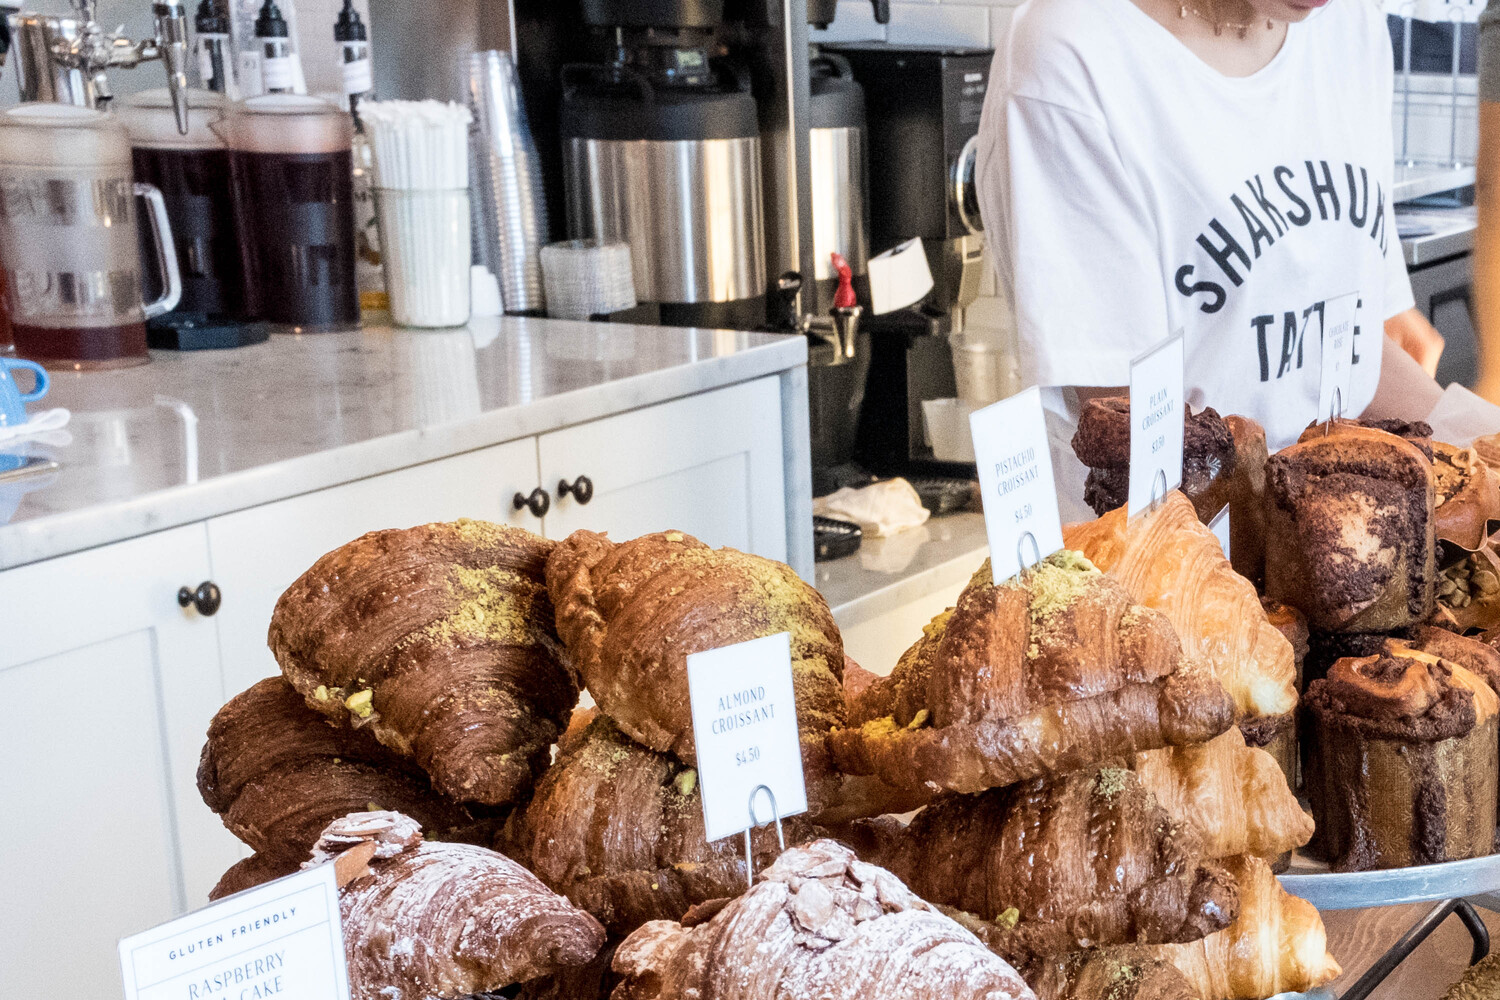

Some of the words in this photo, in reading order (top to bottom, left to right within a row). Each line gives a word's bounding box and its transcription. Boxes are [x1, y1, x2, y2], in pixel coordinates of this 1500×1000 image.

[1174, 160, 1388, 315] SHAKSHUK
[1149, 387, 1168, 408] PLAIN
[1142, 400, 1174, 431] CROISSANT
[995, 447, 1035, 477] PISTACHIO
[997, 464, 1039, 497] CROISSANT
[718, 685, 765, 713] ALMOND
[711, 703, 775, 735] CROISSANT
[168, 934, 223, 961] GLUTEN
[231, 907, 298, 939] FRIENDLY
[188, 950, 286, 1000] RASPBERRY
